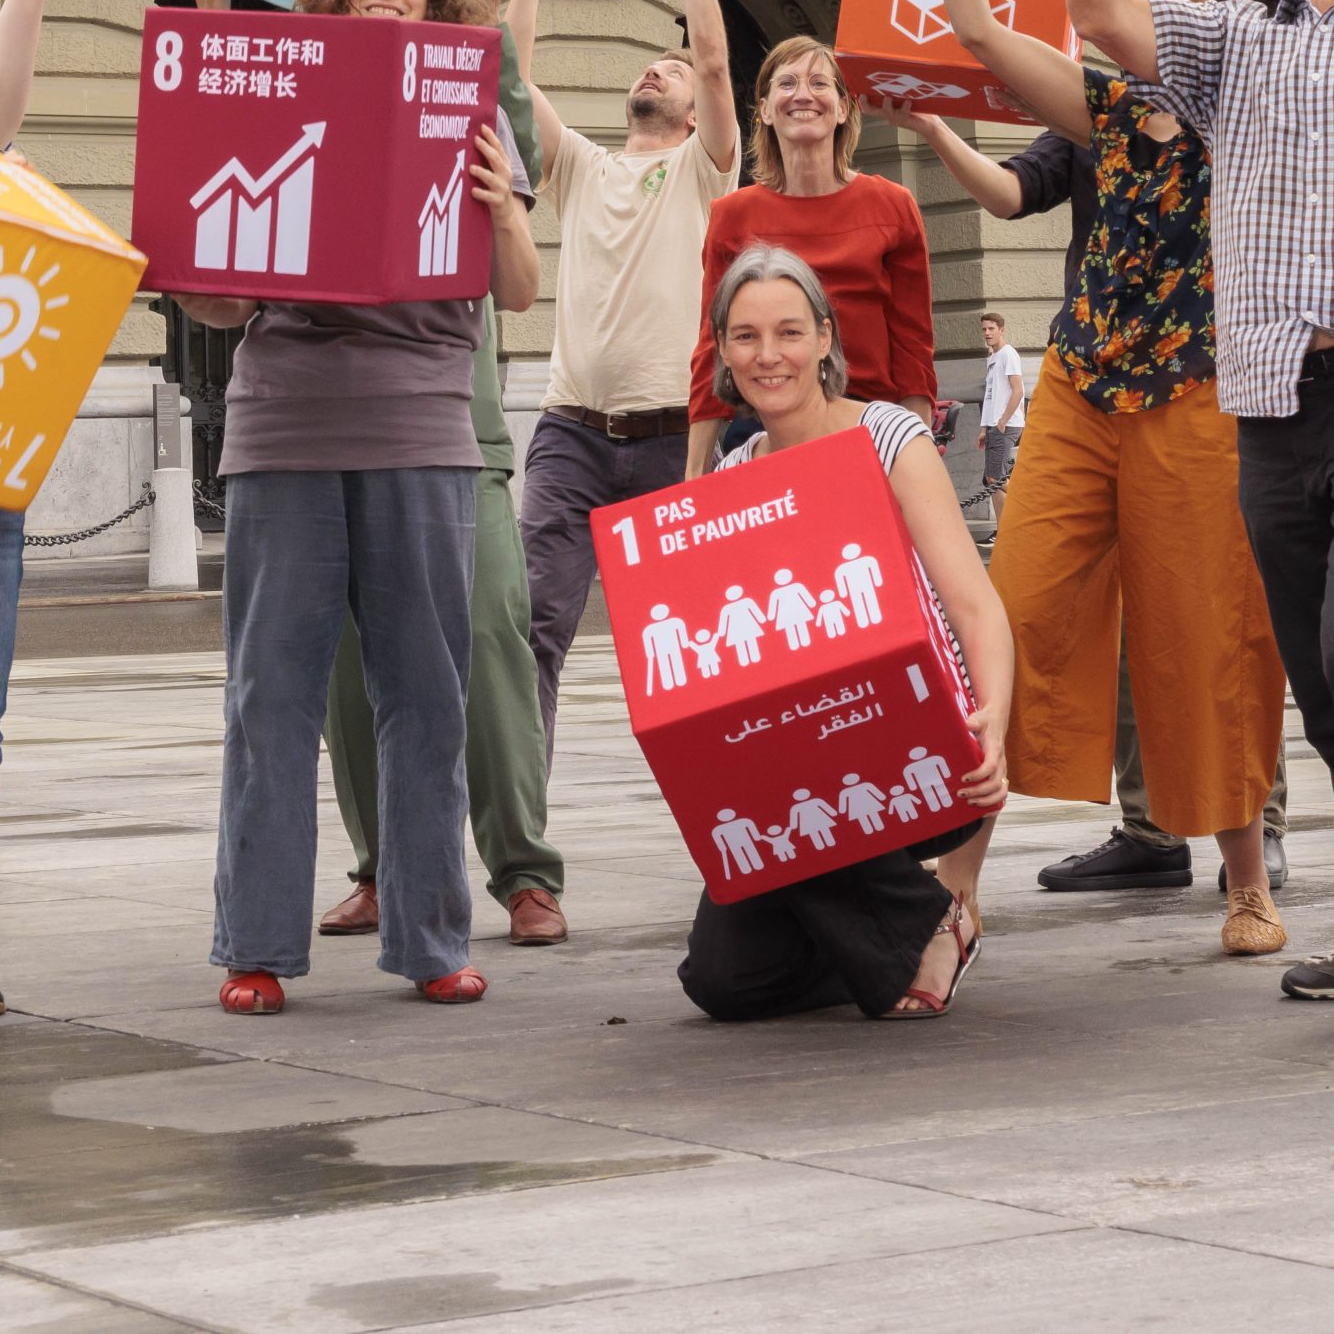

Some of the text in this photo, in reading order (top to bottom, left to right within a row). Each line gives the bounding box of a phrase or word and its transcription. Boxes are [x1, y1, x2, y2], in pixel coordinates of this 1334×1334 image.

[153, 31, 184, 92] 8
[201, 33, 325, 67] 体面工作和
[423, 41, 485, 73] TRAVAIL DÉCENT
[198, 68, 298, 99] 经济增长
[402, 41, 417, 103] 8
[421, 80, 479, 107] ET CROISSANCE
[419, 107, 471, 142] ÉCONOMIQUE
[2, 424, 16, 450] Y
[4, 433, 46, 490] 7
[654, 496, 696, 528] PAS
[659, 488, 800, 556] DE PAUVRETÉ
[612, 517, 641, 566] 1
[724, 681, 876, 744] القضاء على
[817, 703, 884, 742] الفقر
